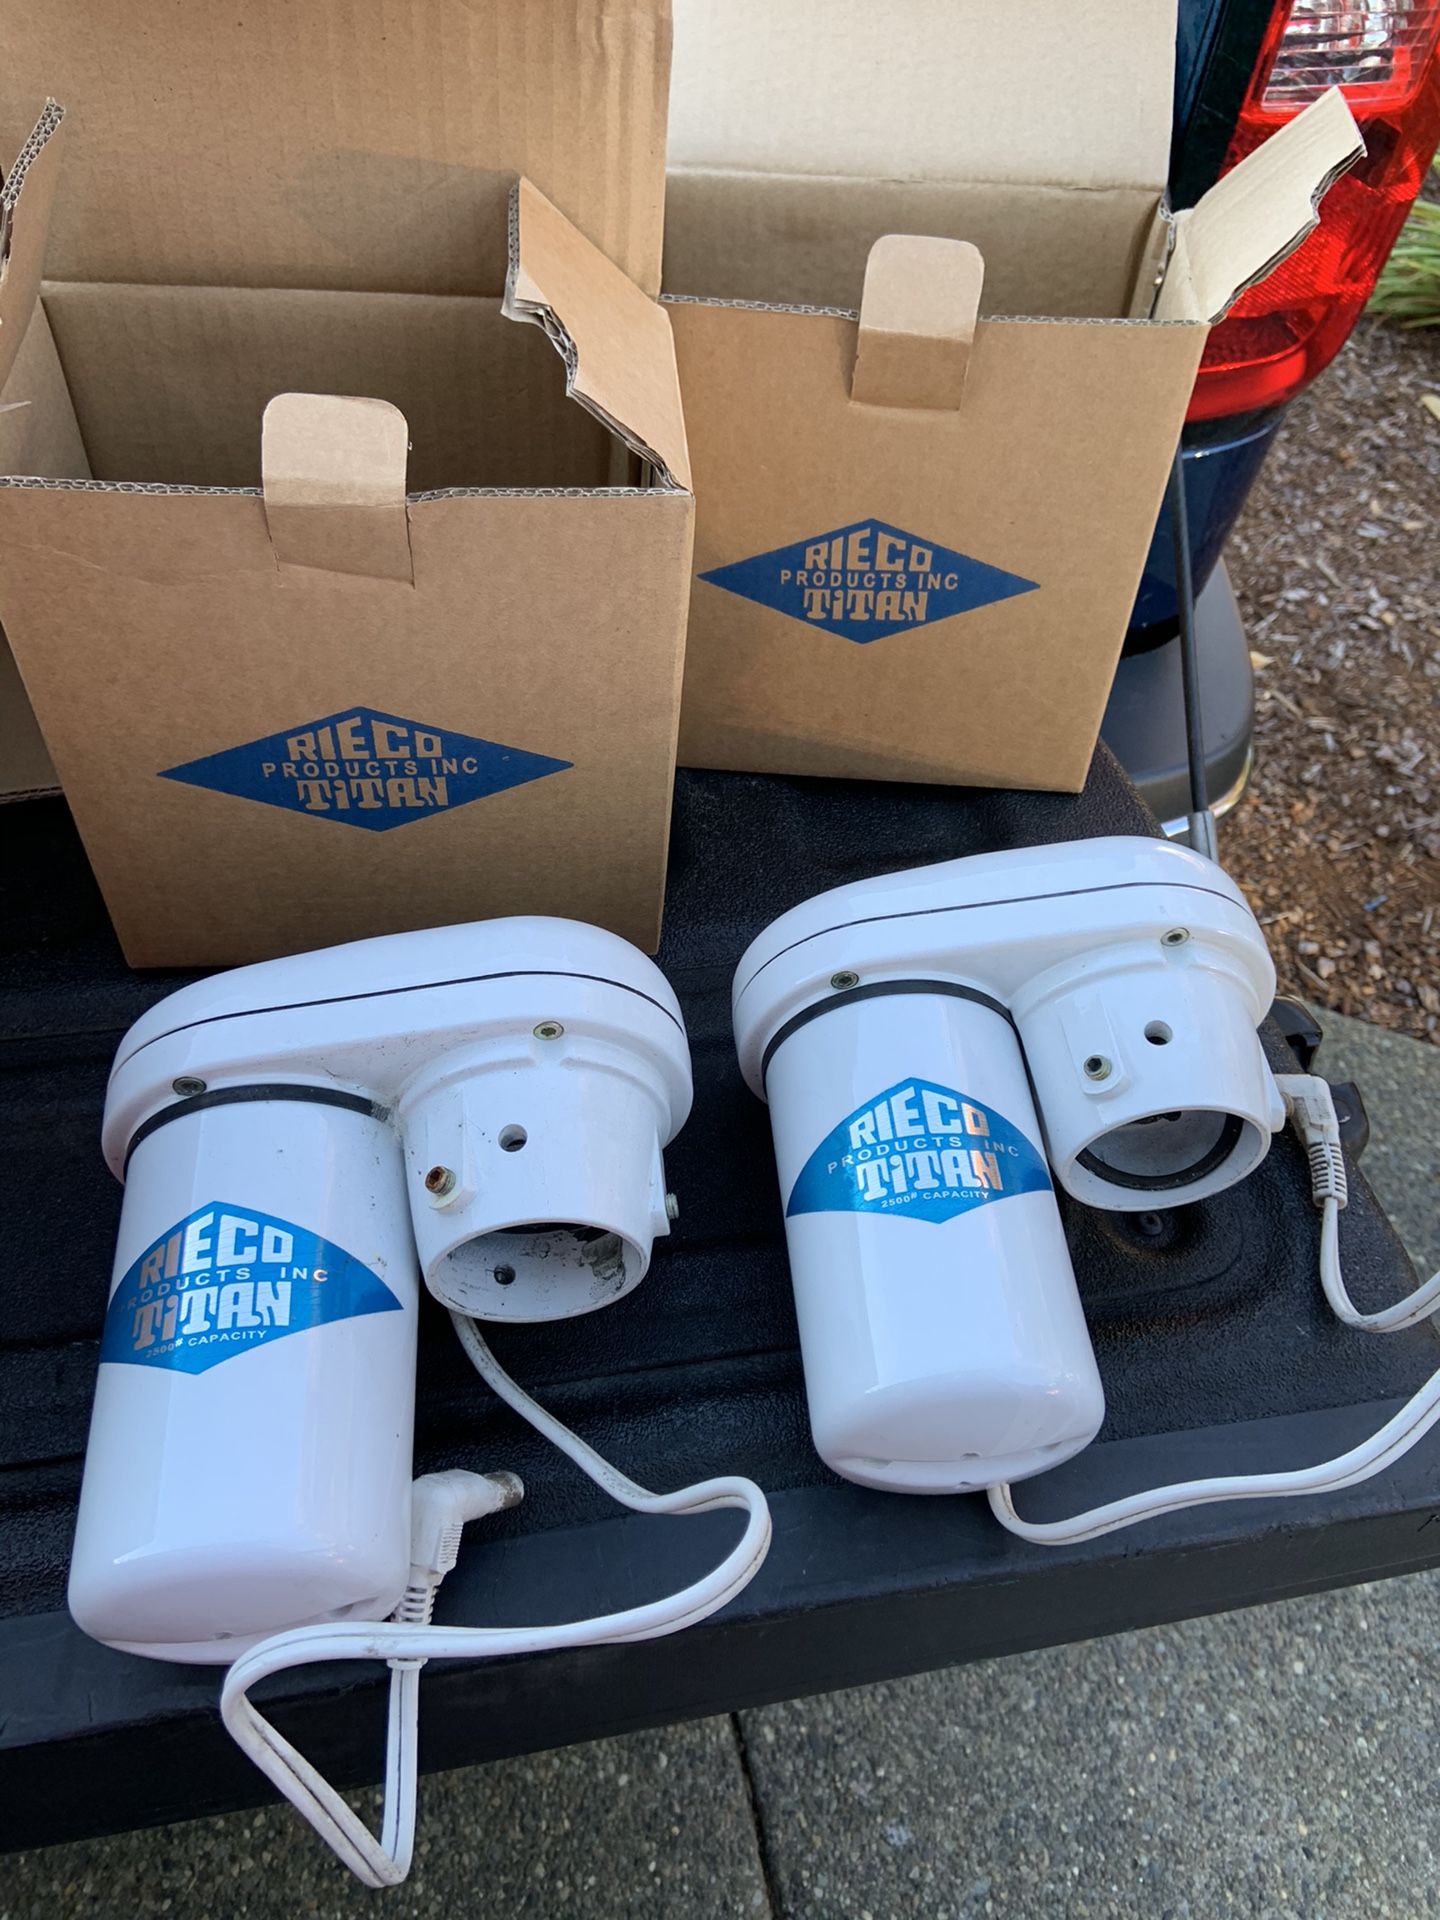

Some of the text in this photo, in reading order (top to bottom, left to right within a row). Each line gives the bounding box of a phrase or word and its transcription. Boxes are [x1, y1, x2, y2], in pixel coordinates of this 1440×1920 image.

[804, 527, 933, 572] RIECO
[780, 569, 959, 590] PRODUCTS INC
[287, 716, 442, 762] RIECO
[262, 757, 479, 778] PRODUCTS INC
[849, 1086, 989, 1150] RIECO
[827, 1136, 1019, 1175] PRODUCTS INC
[922, 1190, 990, 1201] CAPACITY
[139, 1211, 294, 1290] RIECO
[118, 1266, 329, 1313] RODUCTS INC
[187, 1330, 267, 1347] CAPACITY
